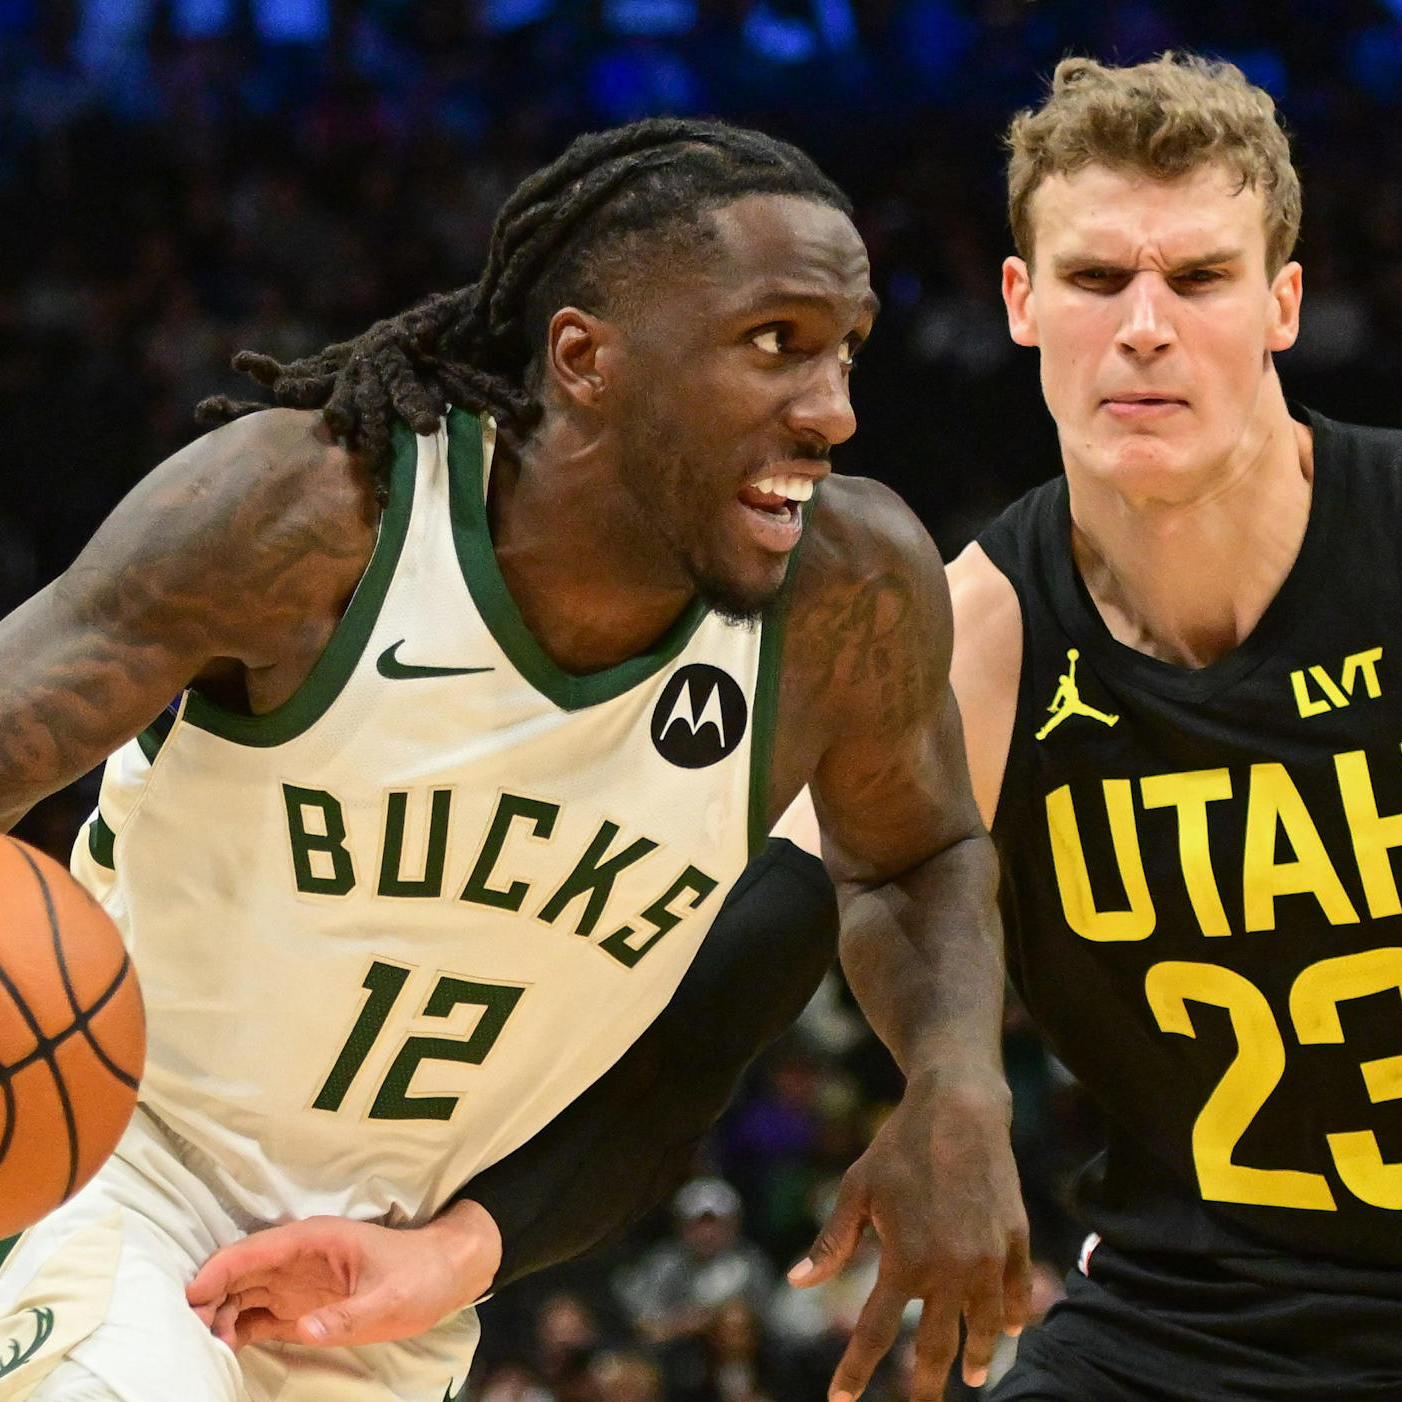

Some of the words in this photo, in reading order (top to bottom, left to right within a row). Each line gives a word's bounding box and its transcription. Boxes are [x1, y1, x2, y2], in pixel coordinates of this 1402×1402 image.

[1290, 647, 1383, 718] LVT
[281, 783, 719, 969] BUCKS
[310, 961, 526, 1121] 12
